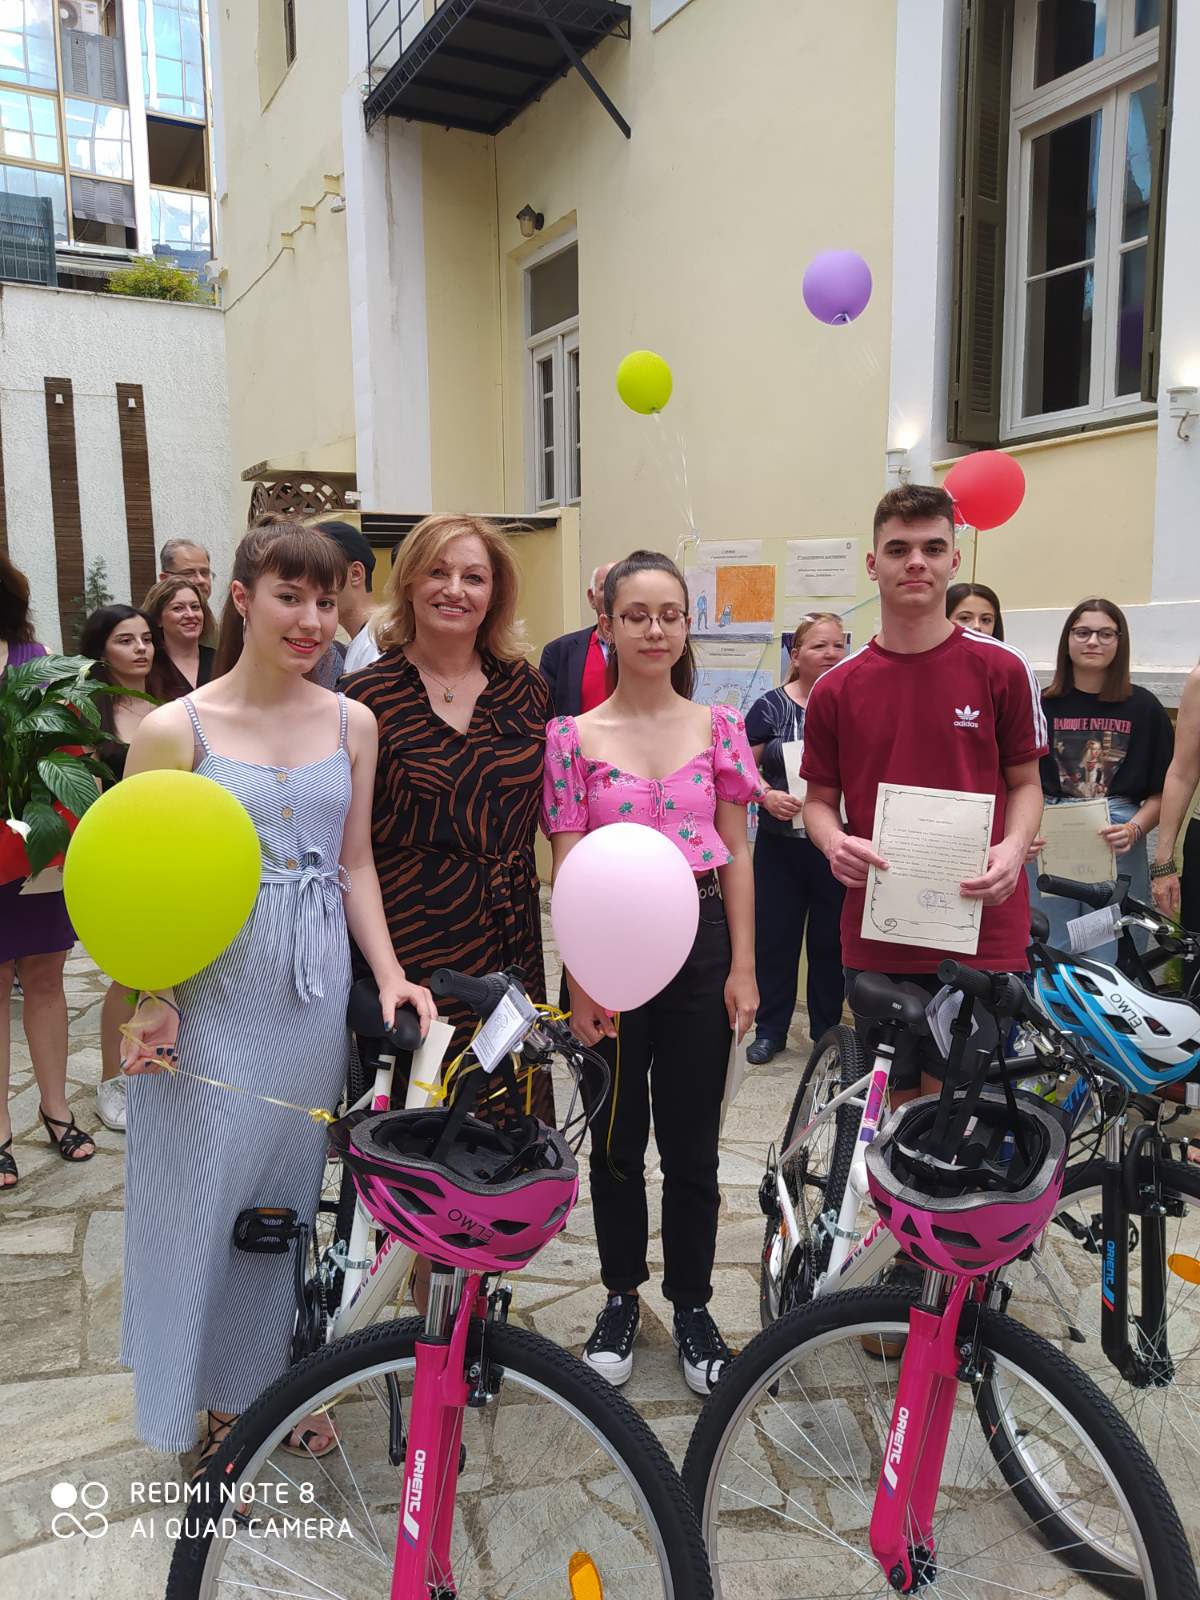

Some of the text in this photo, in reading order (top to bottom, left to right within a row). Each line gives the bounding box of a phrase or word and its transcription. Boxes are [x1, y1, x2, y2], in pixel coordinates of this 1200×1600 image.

[1110, 993, 1143, 1029] ELMO
[447, 1208, 496, 1242] ELMO
[1106, 1240, 1116, 1285] ORIENT
[890, 1406, 910, 1465] ORIENT
[409, 1449, 427, 1513] ORIENT
